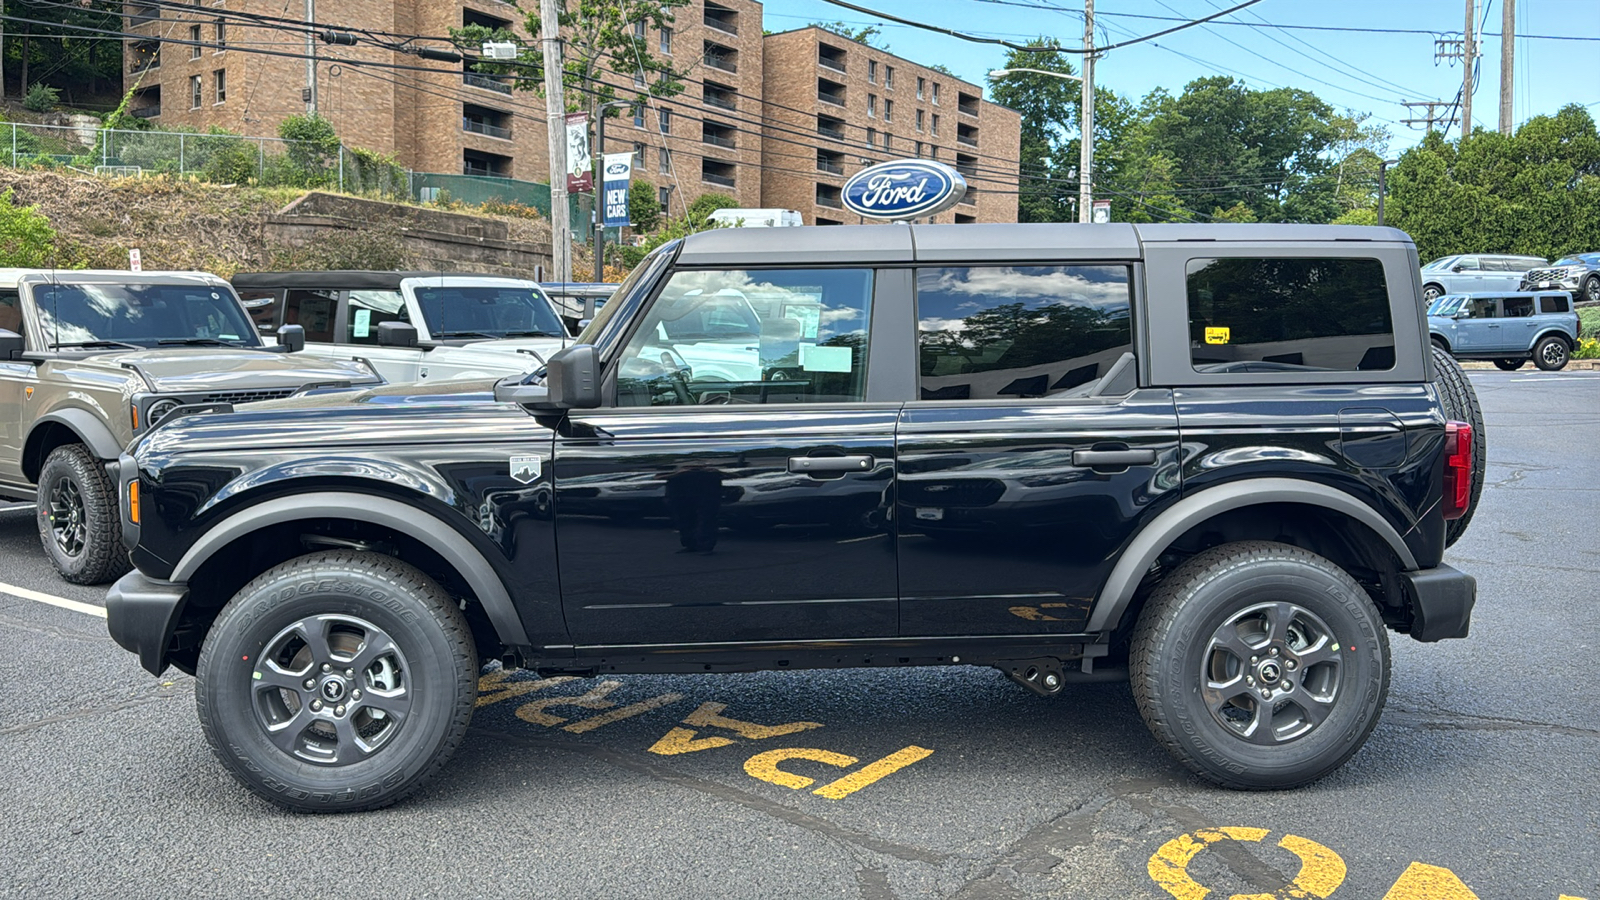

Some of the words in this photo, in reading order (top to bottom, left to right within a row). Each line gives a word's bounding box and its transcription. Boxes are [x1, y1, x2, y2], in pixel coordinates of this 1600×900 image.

[608, 164, 626, 174] Ford
[606, 188, 626, 205] NEW
[862, 172, 928, 208] Ford
[607, 204, 626, 219] CARS
[237, 578, 420, 637] BRIDGESTONE
[1324, 584, 1382, 705] DUELER
[1169, 624, 1249, 775] BRIDGESTONE
[262, 765, 406, 804] DUELER
